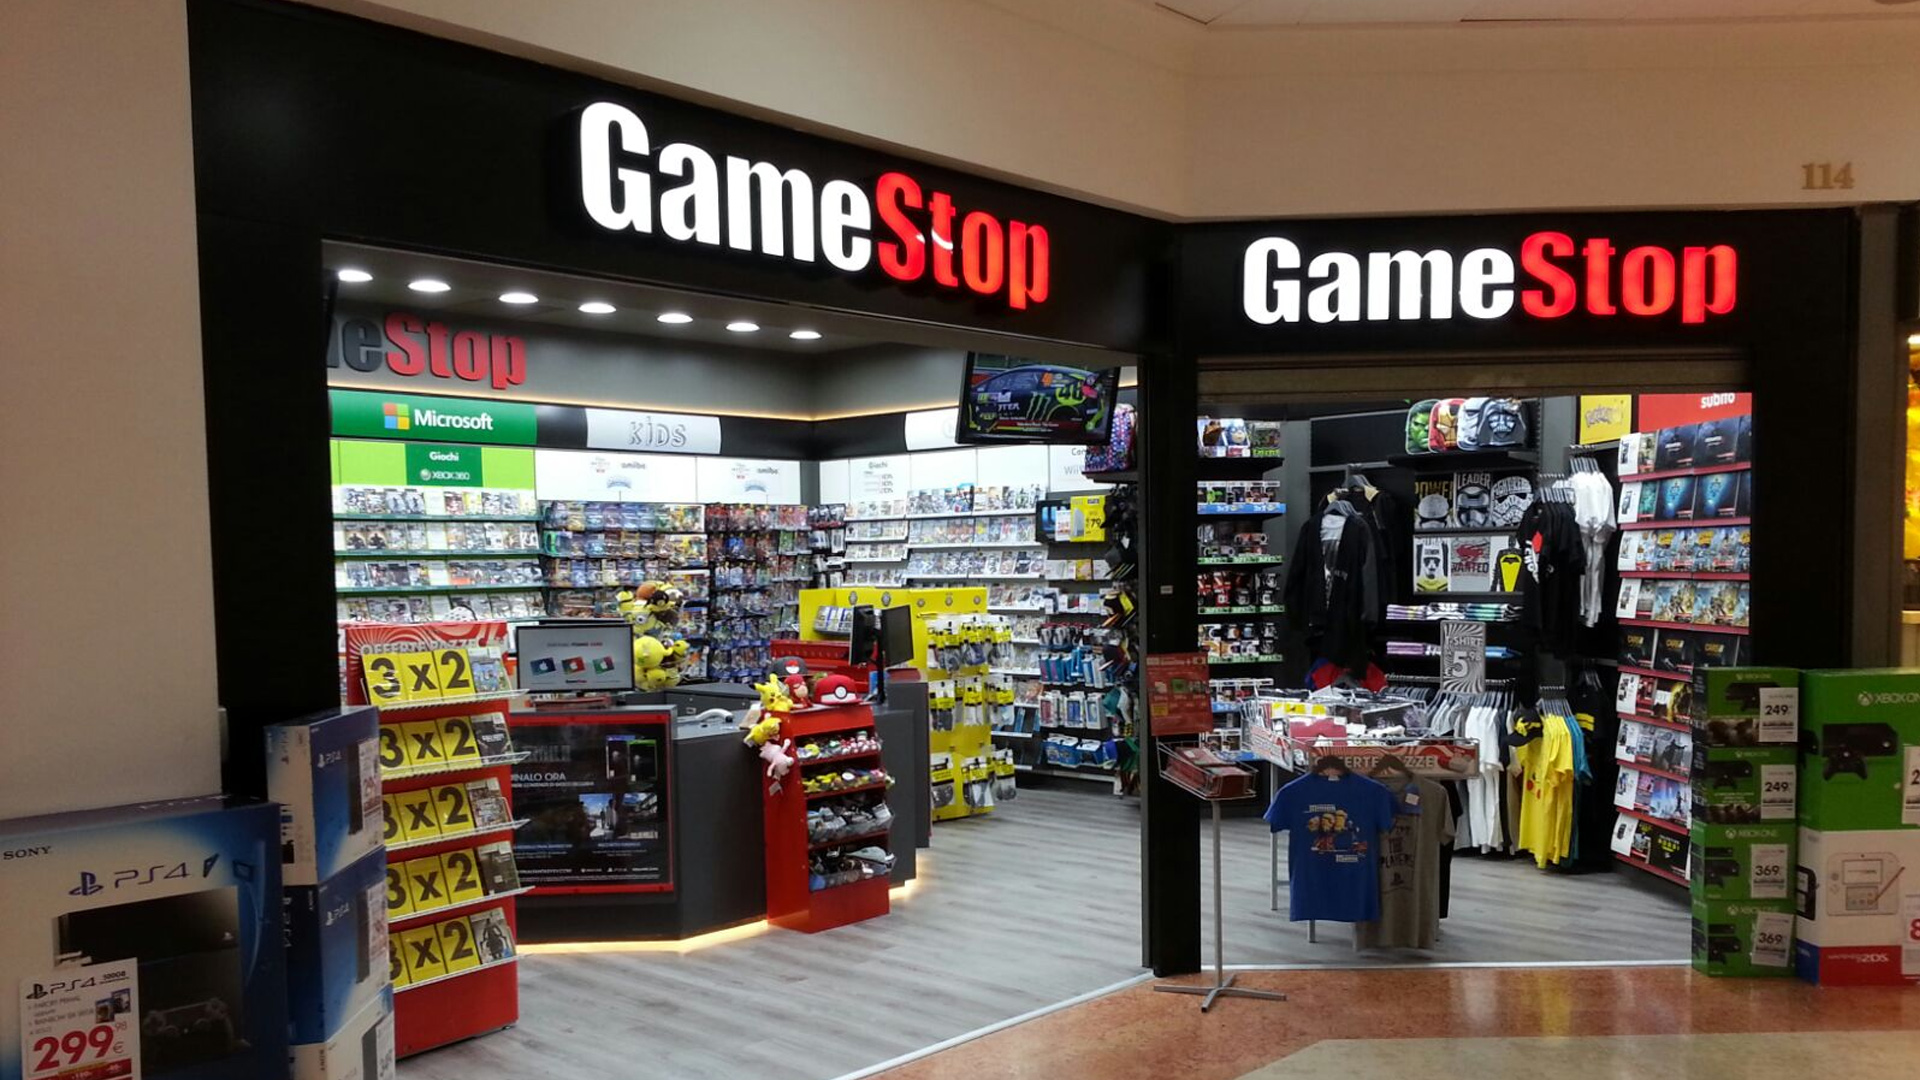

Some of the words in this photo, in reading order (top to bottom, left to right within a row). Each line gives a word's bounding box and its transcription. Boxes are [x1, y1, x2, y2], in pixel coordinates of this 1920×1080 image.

[1801, 161, 1855, 189] 114
[580, 101, 1049, 309] GameStop
[1243, 231, 1737, 325] GameStop
[327, 312, 526, 389] eStop
[414, 409, 493, 430] Microsoft
[429, 451, 459, 461] Giochi
[1458, 472, 1491, 490] LEADER
[1451, 561, 1489, 573] WANTED
[1765, 704, 1788, 716] 249
[544, 772, 567, 781] ORA
[1765, 781, 1788, 793] 249
[3, 846, 51, 861] SONY
[114, 862, 191, 888] PS4
[1755, 865, 1780, 876] 369
[1758, 933, 1783, 945] 369
[50, 977, 96, 994] PS4
[33, 1025, 114, 1073] 299
